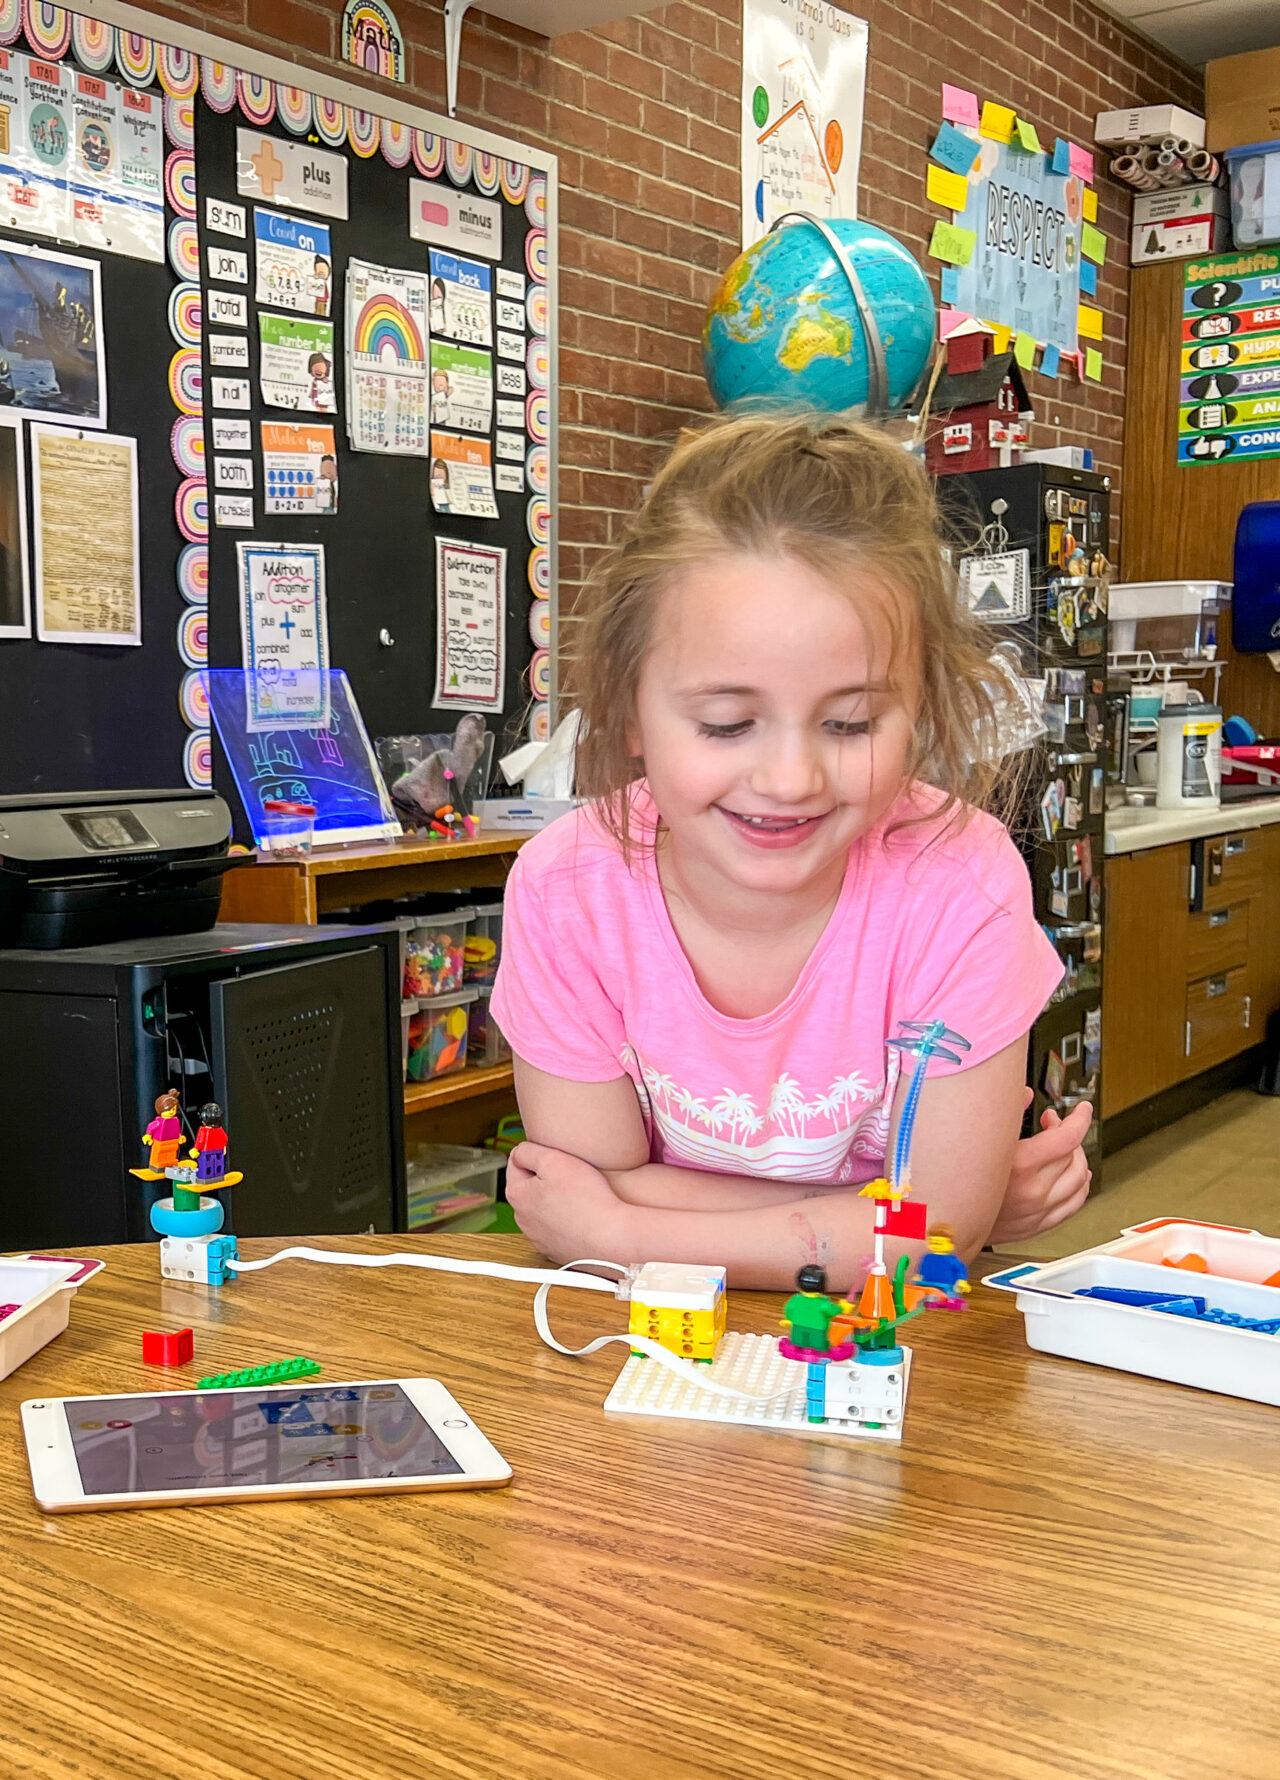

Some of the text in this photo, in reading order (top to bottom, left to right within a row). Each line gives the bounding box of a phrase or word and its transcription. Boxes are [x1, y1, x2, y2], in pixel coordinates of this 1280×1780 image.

[345, 11, 402, 56] Math
[36, 65, 53, 79] 1781
[303, 161, 331, 185] plus
[458, 207, 493, 229] minus
[985, 181, 1065, 274] RESPECT
[298, 234, 316, 251] on
[1187, 254, 1279, 282] Scientific
[458, 269, 481, 288] back
[306, 437, 326, 453] ten
[220, 463, 248, 481] both
[262, 561, 303, 577] Addition
[447, 556, 495, 576] Subtraction
